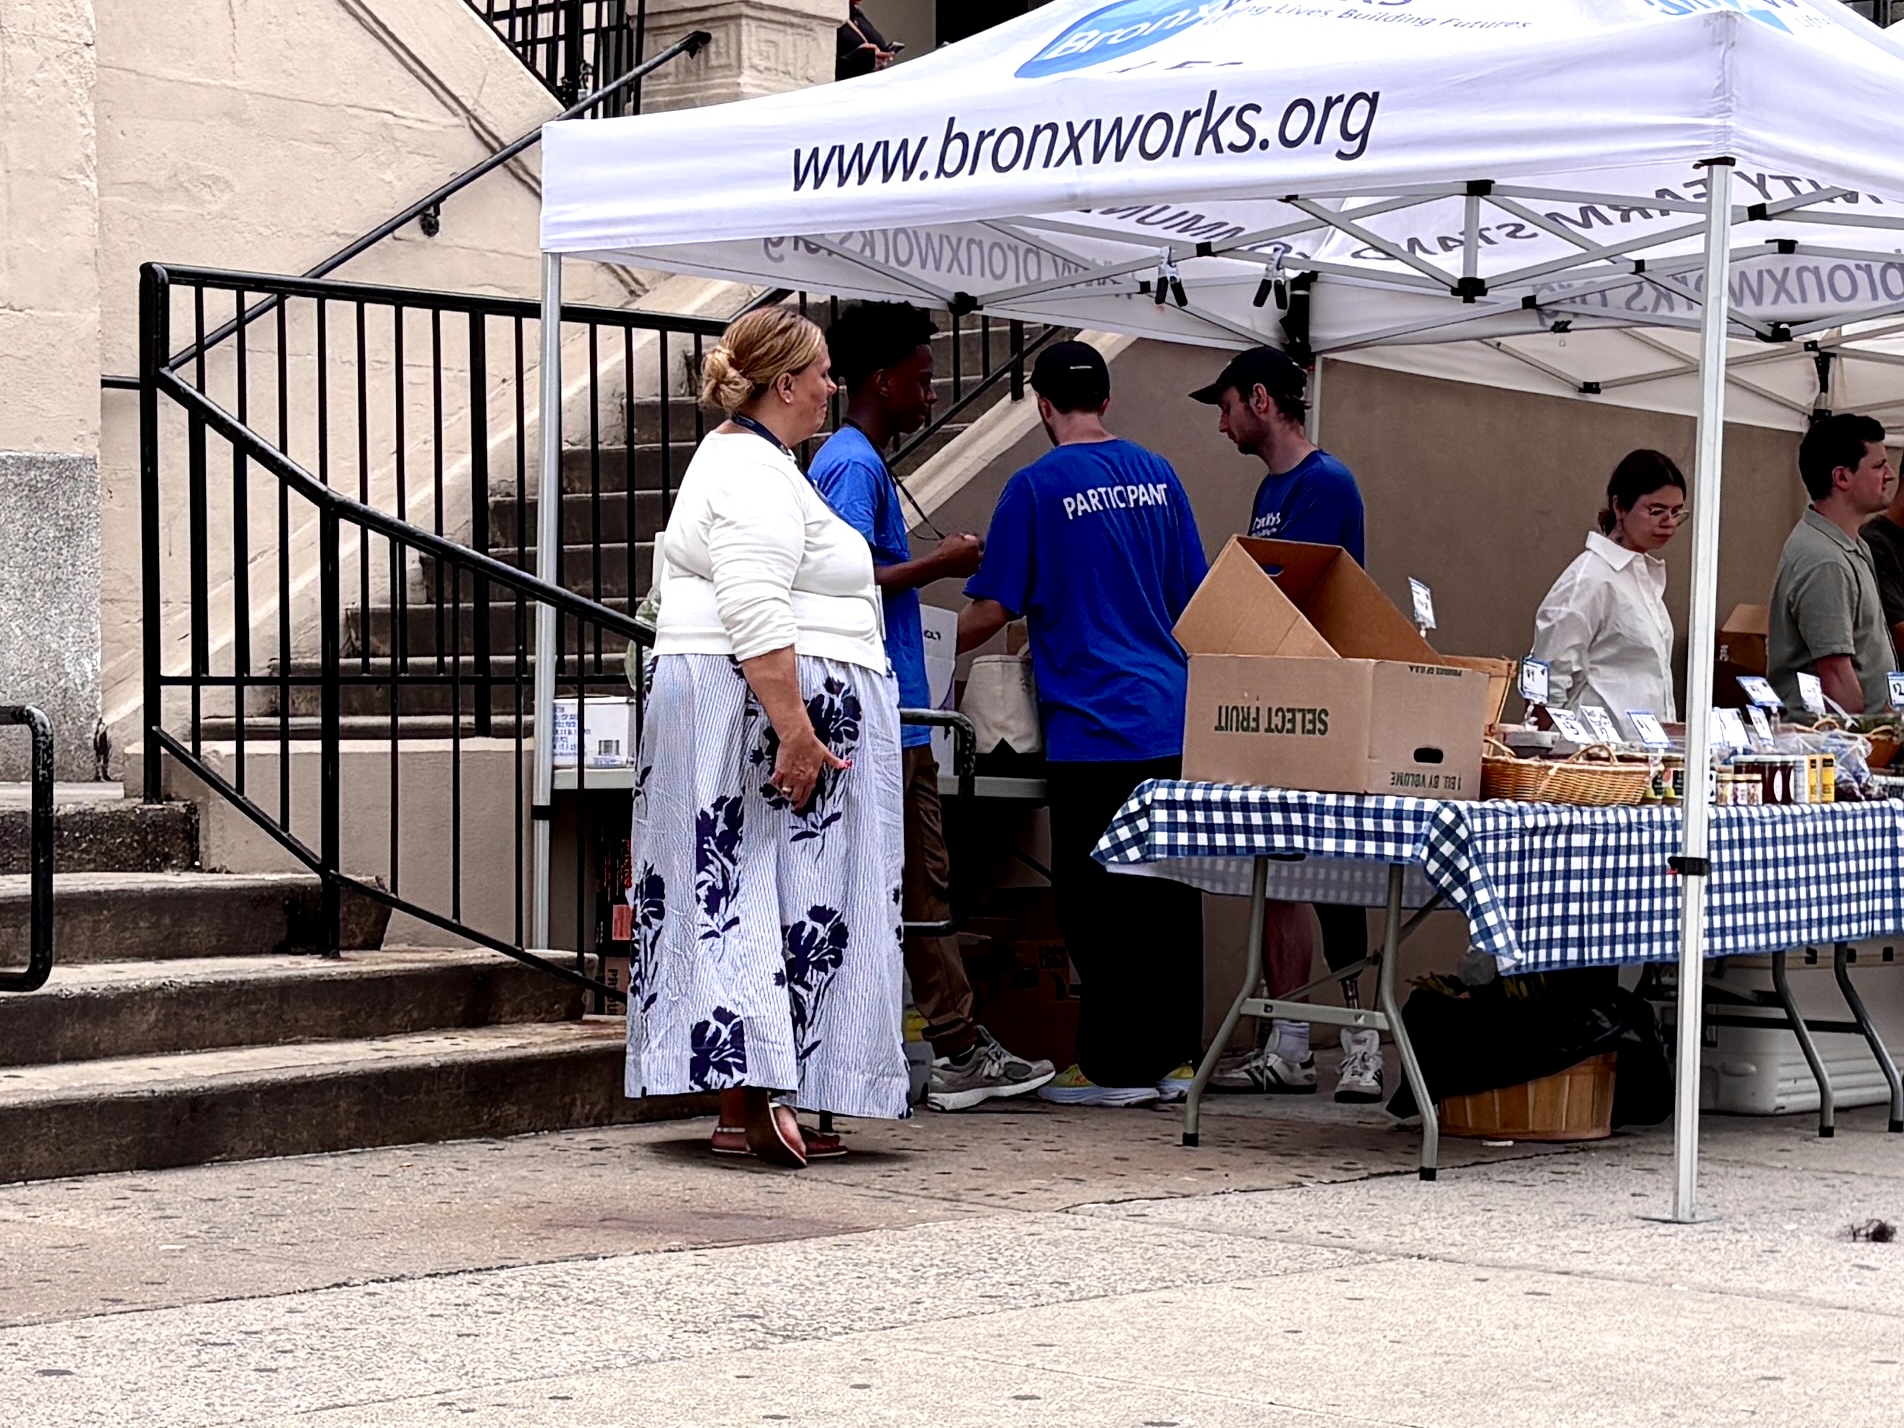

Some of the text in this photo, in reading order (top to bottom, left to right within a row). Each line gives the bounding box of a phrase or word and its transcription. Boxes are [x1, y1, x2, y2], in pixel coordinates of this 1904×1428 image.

[1337, 8, 1437, 28] Building
[793, 89, 1381, 192] www.bronxworks.org
[1063, 483, 1168, 520] PARTICIPANT
[1214, 704, 1329, 736] SELECT FRUIT
[1390, 771, 1426, 788] VOLUME
[1429, 774, 1440, 789] BY
